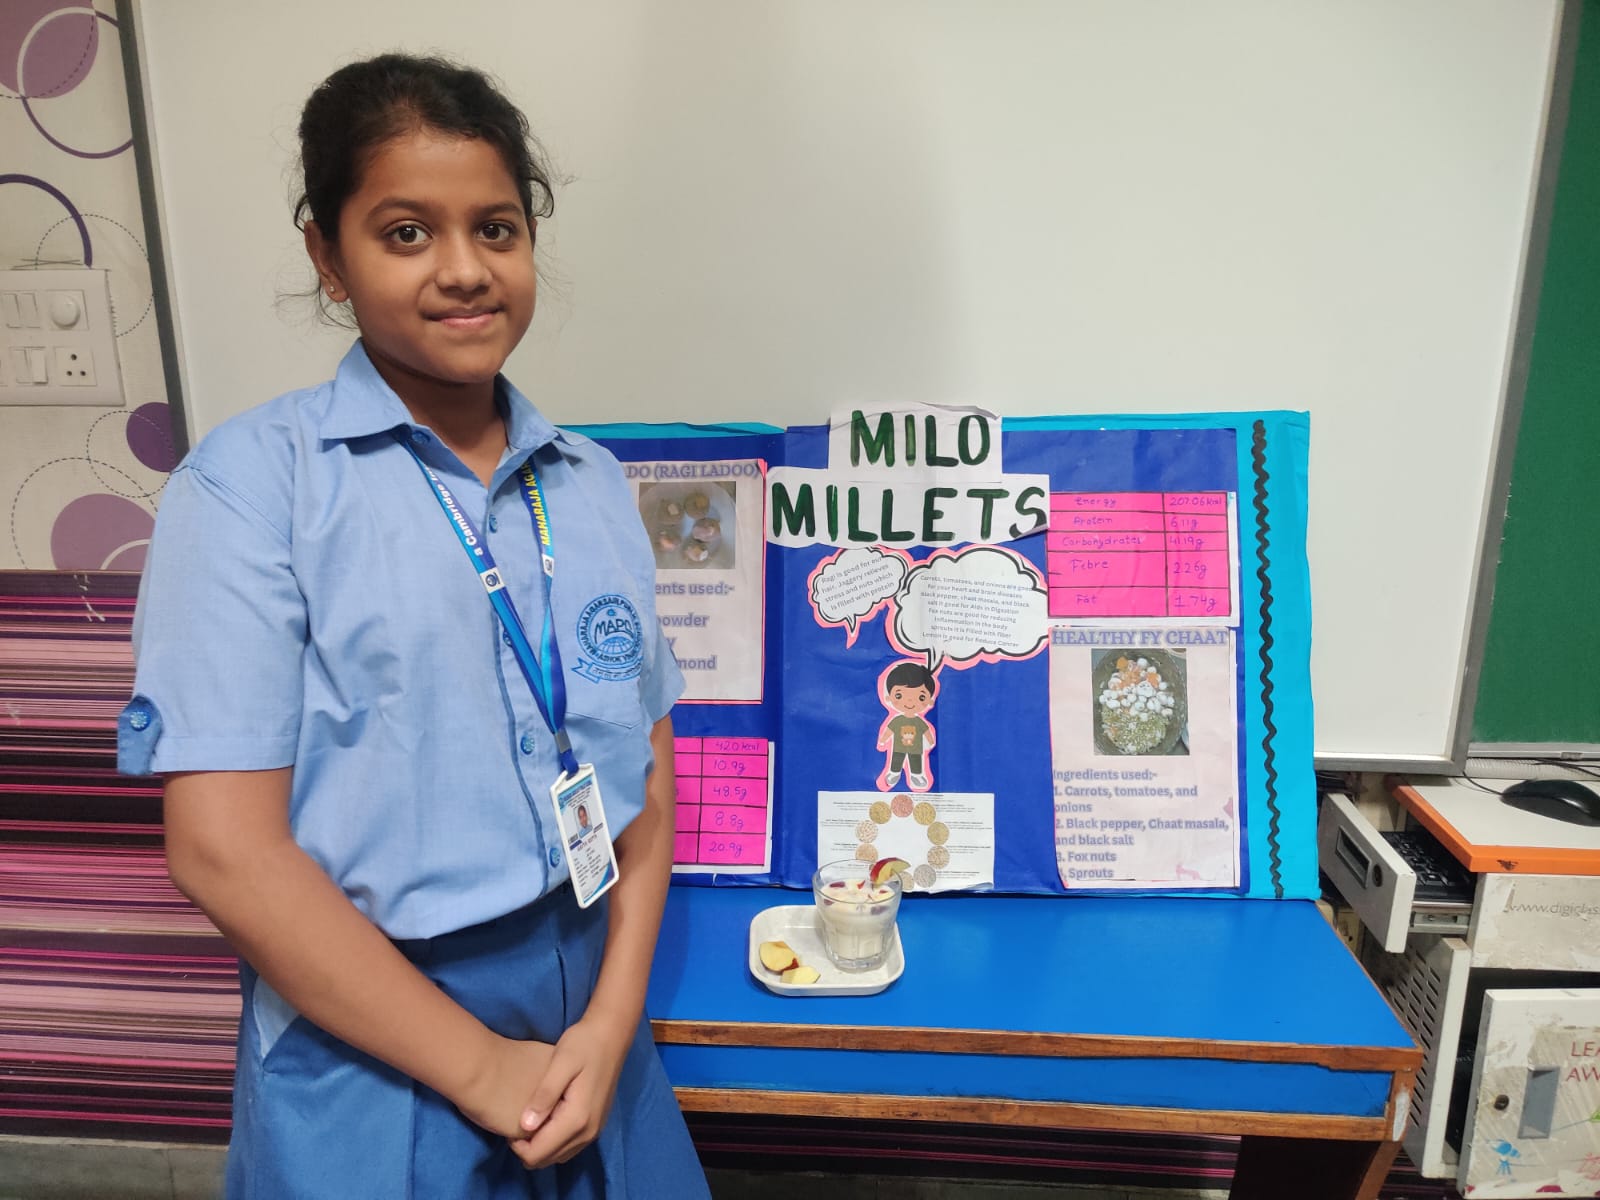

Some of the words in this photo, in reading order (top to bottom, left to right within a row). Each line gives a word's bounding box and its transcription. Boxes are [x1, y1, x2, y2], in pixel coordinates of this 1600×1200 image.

[850, 409, 991, 467] MILO
[654, 464, 696, 480] (RAGI
[701, 463, 759, 479] LADOO)
[1074, 496, 1117, 508] Energy
[437, 484, 478, 546] Cambridge
[528, 489, 550, 545] MAHARAJA
[771, 482, 1047, 542] MILLETS
[1073, 516, 1113, 526] Protein
[1062, 535, 1142, 549] Carbohydrates
[474, 547, 484, 557] a
[655, 582, 686, 594] ents
[846, 586, 858, 595] and
[1076, 594, 1097, 604] Fat
[1053, 630, 1137, 645] HEALTHY
[1140, 630, 1163, 645] FY
[1166, 630, 1228, 645] CHAAT
[1065, 786, 1112, 798] Carrots,
[1115, 786, 1173, 798] tomatoes,
[1176, 785, 1198, 796] and
[1055, 802, 1093, 812] onions
[1066, 818, 1099, 829] Black
[1100, 820, 1146, 831] pepper,
[1148, 818, 1183, 829] Chaat
[1185, 818, 1229, 831] masala,
[1056, 834, 1076, 845] and
[1078, 834, 1110, 845] black
[1112, 834, 1134, 845] salt
[1068, 852, 1088, 862] Fox
[1090, 853, 1117, 862] nuts
[1068, 867, 1114, 880] Sprouts
